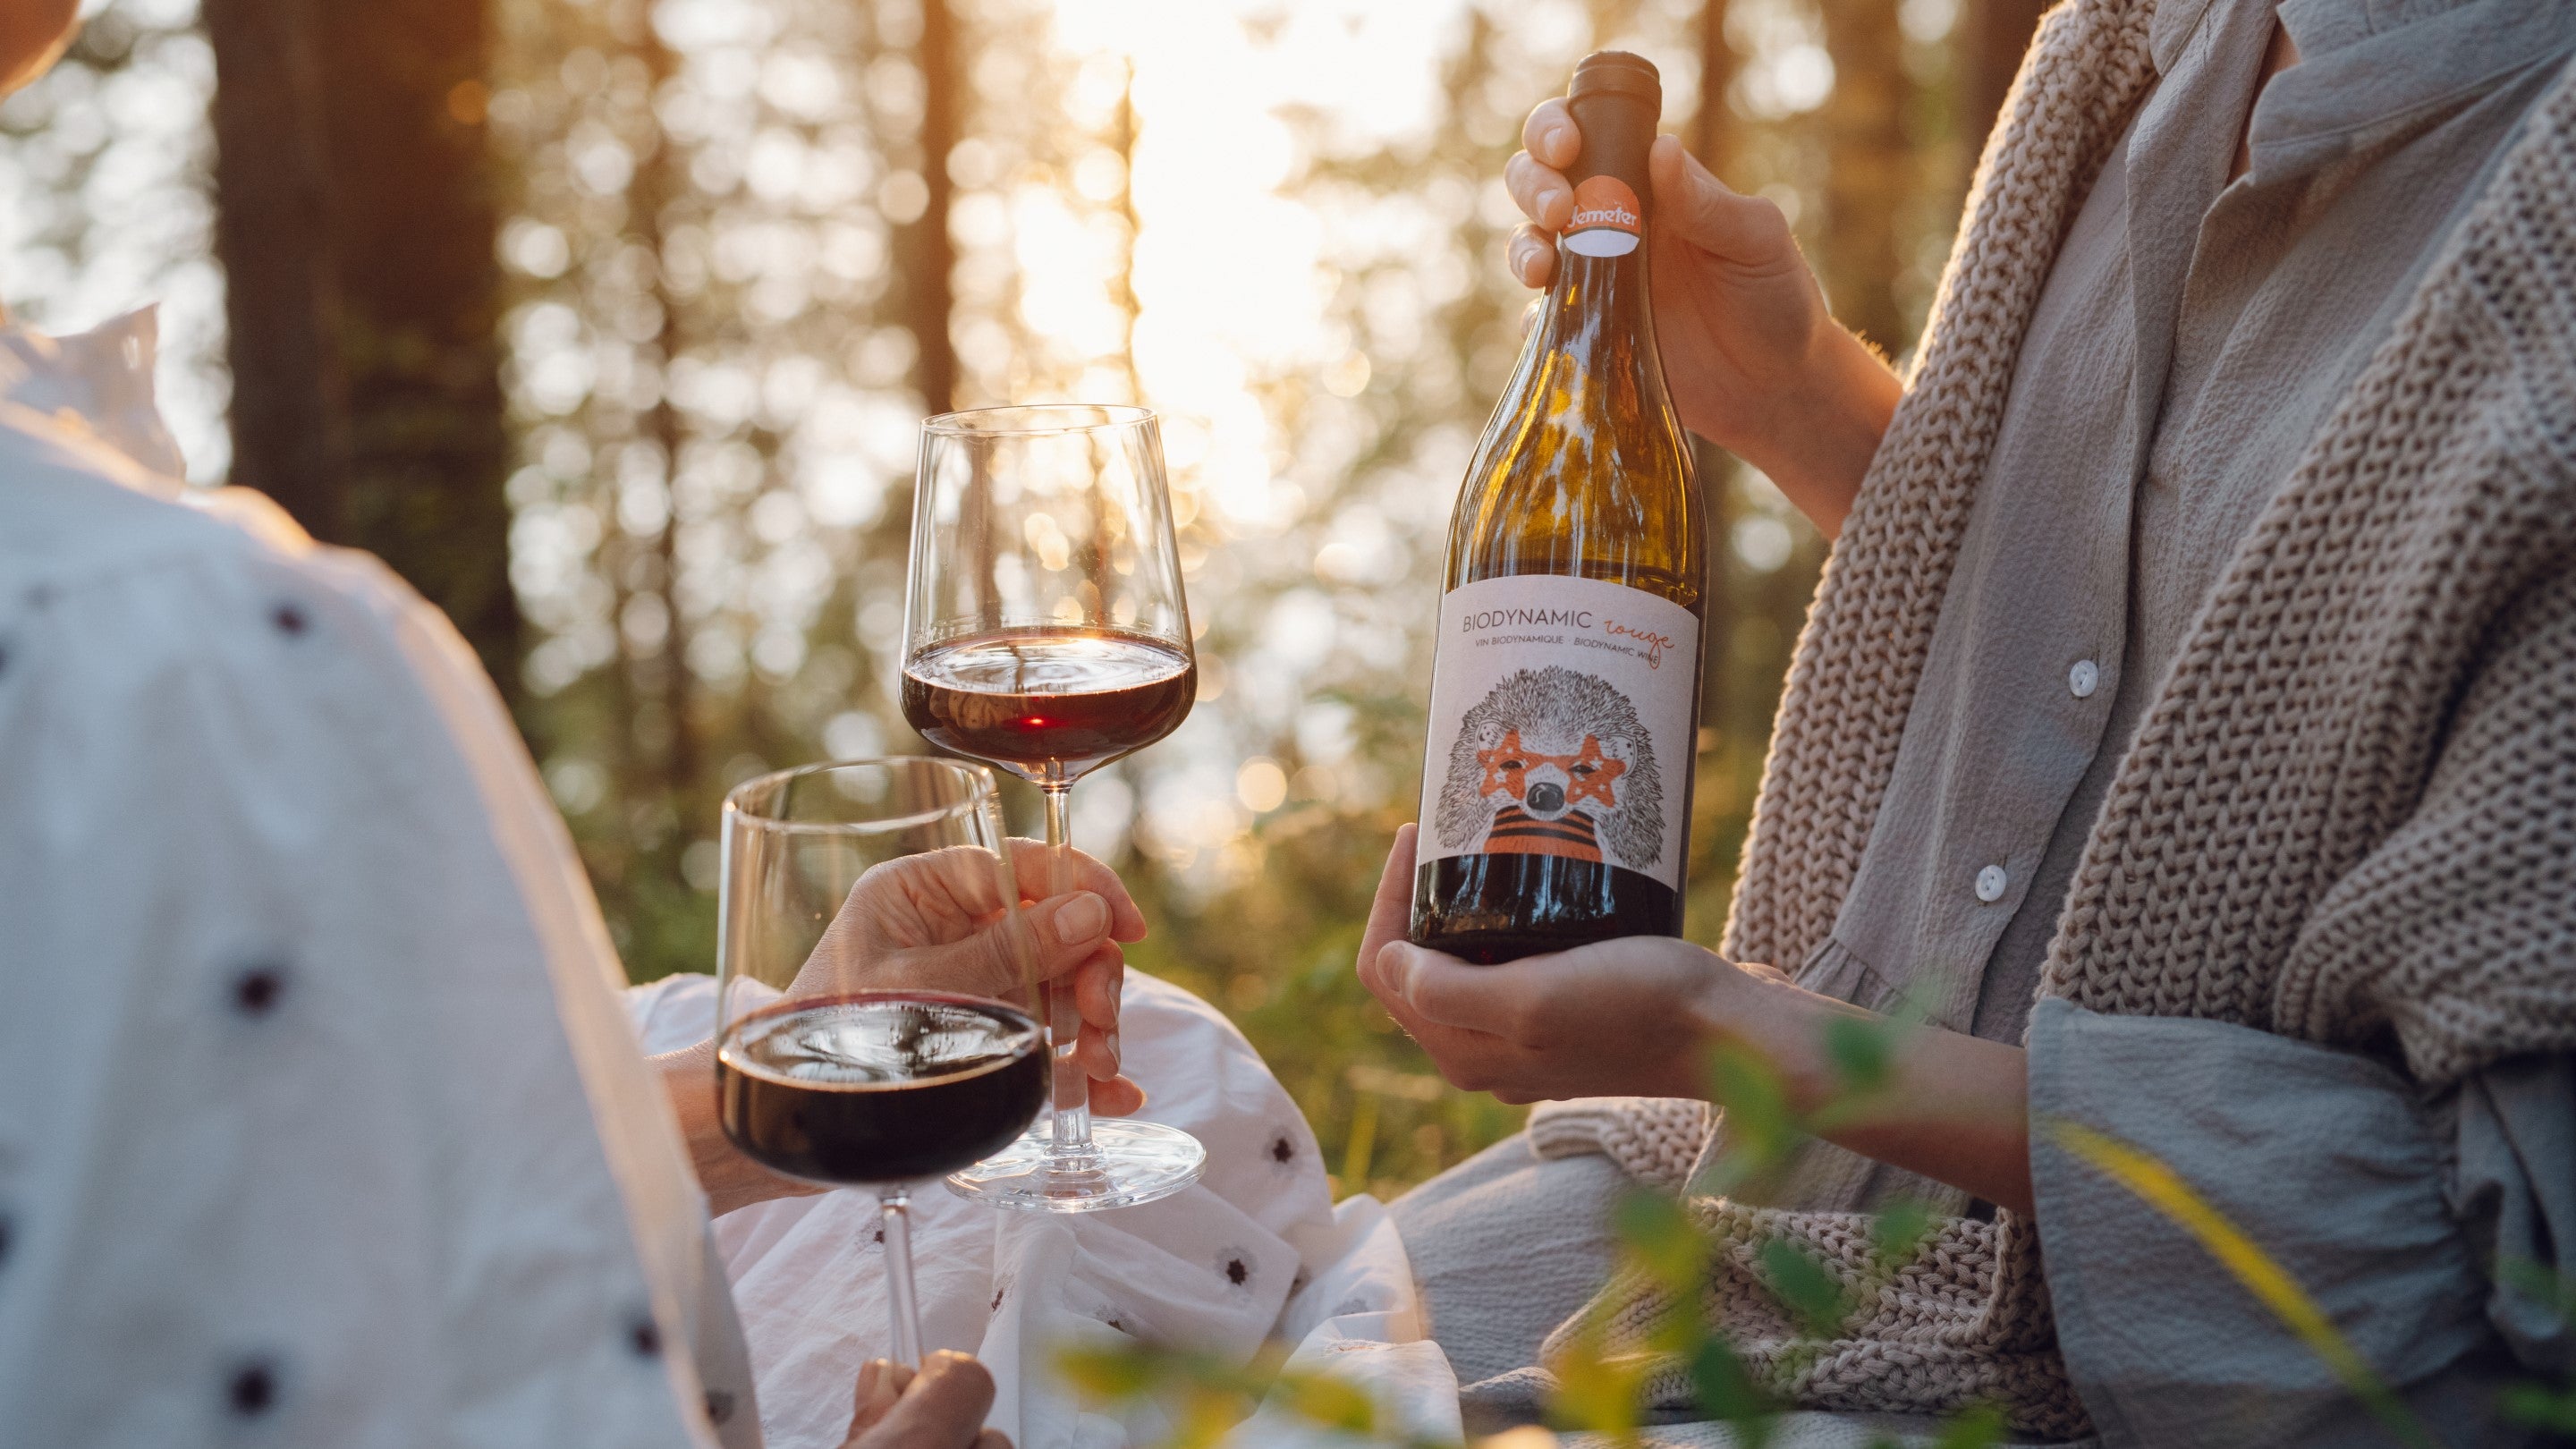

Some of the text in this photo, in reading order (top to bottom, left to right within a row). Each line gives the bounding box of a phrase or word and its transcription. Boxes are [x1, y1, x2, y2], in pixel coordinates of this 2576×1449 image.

[1462, 608, 1675, 670] BIODYNAMIC rouge
[1475, 635, 1658, 665] VIN BIODYNAMIQUE BIODYNAMIC WINE
